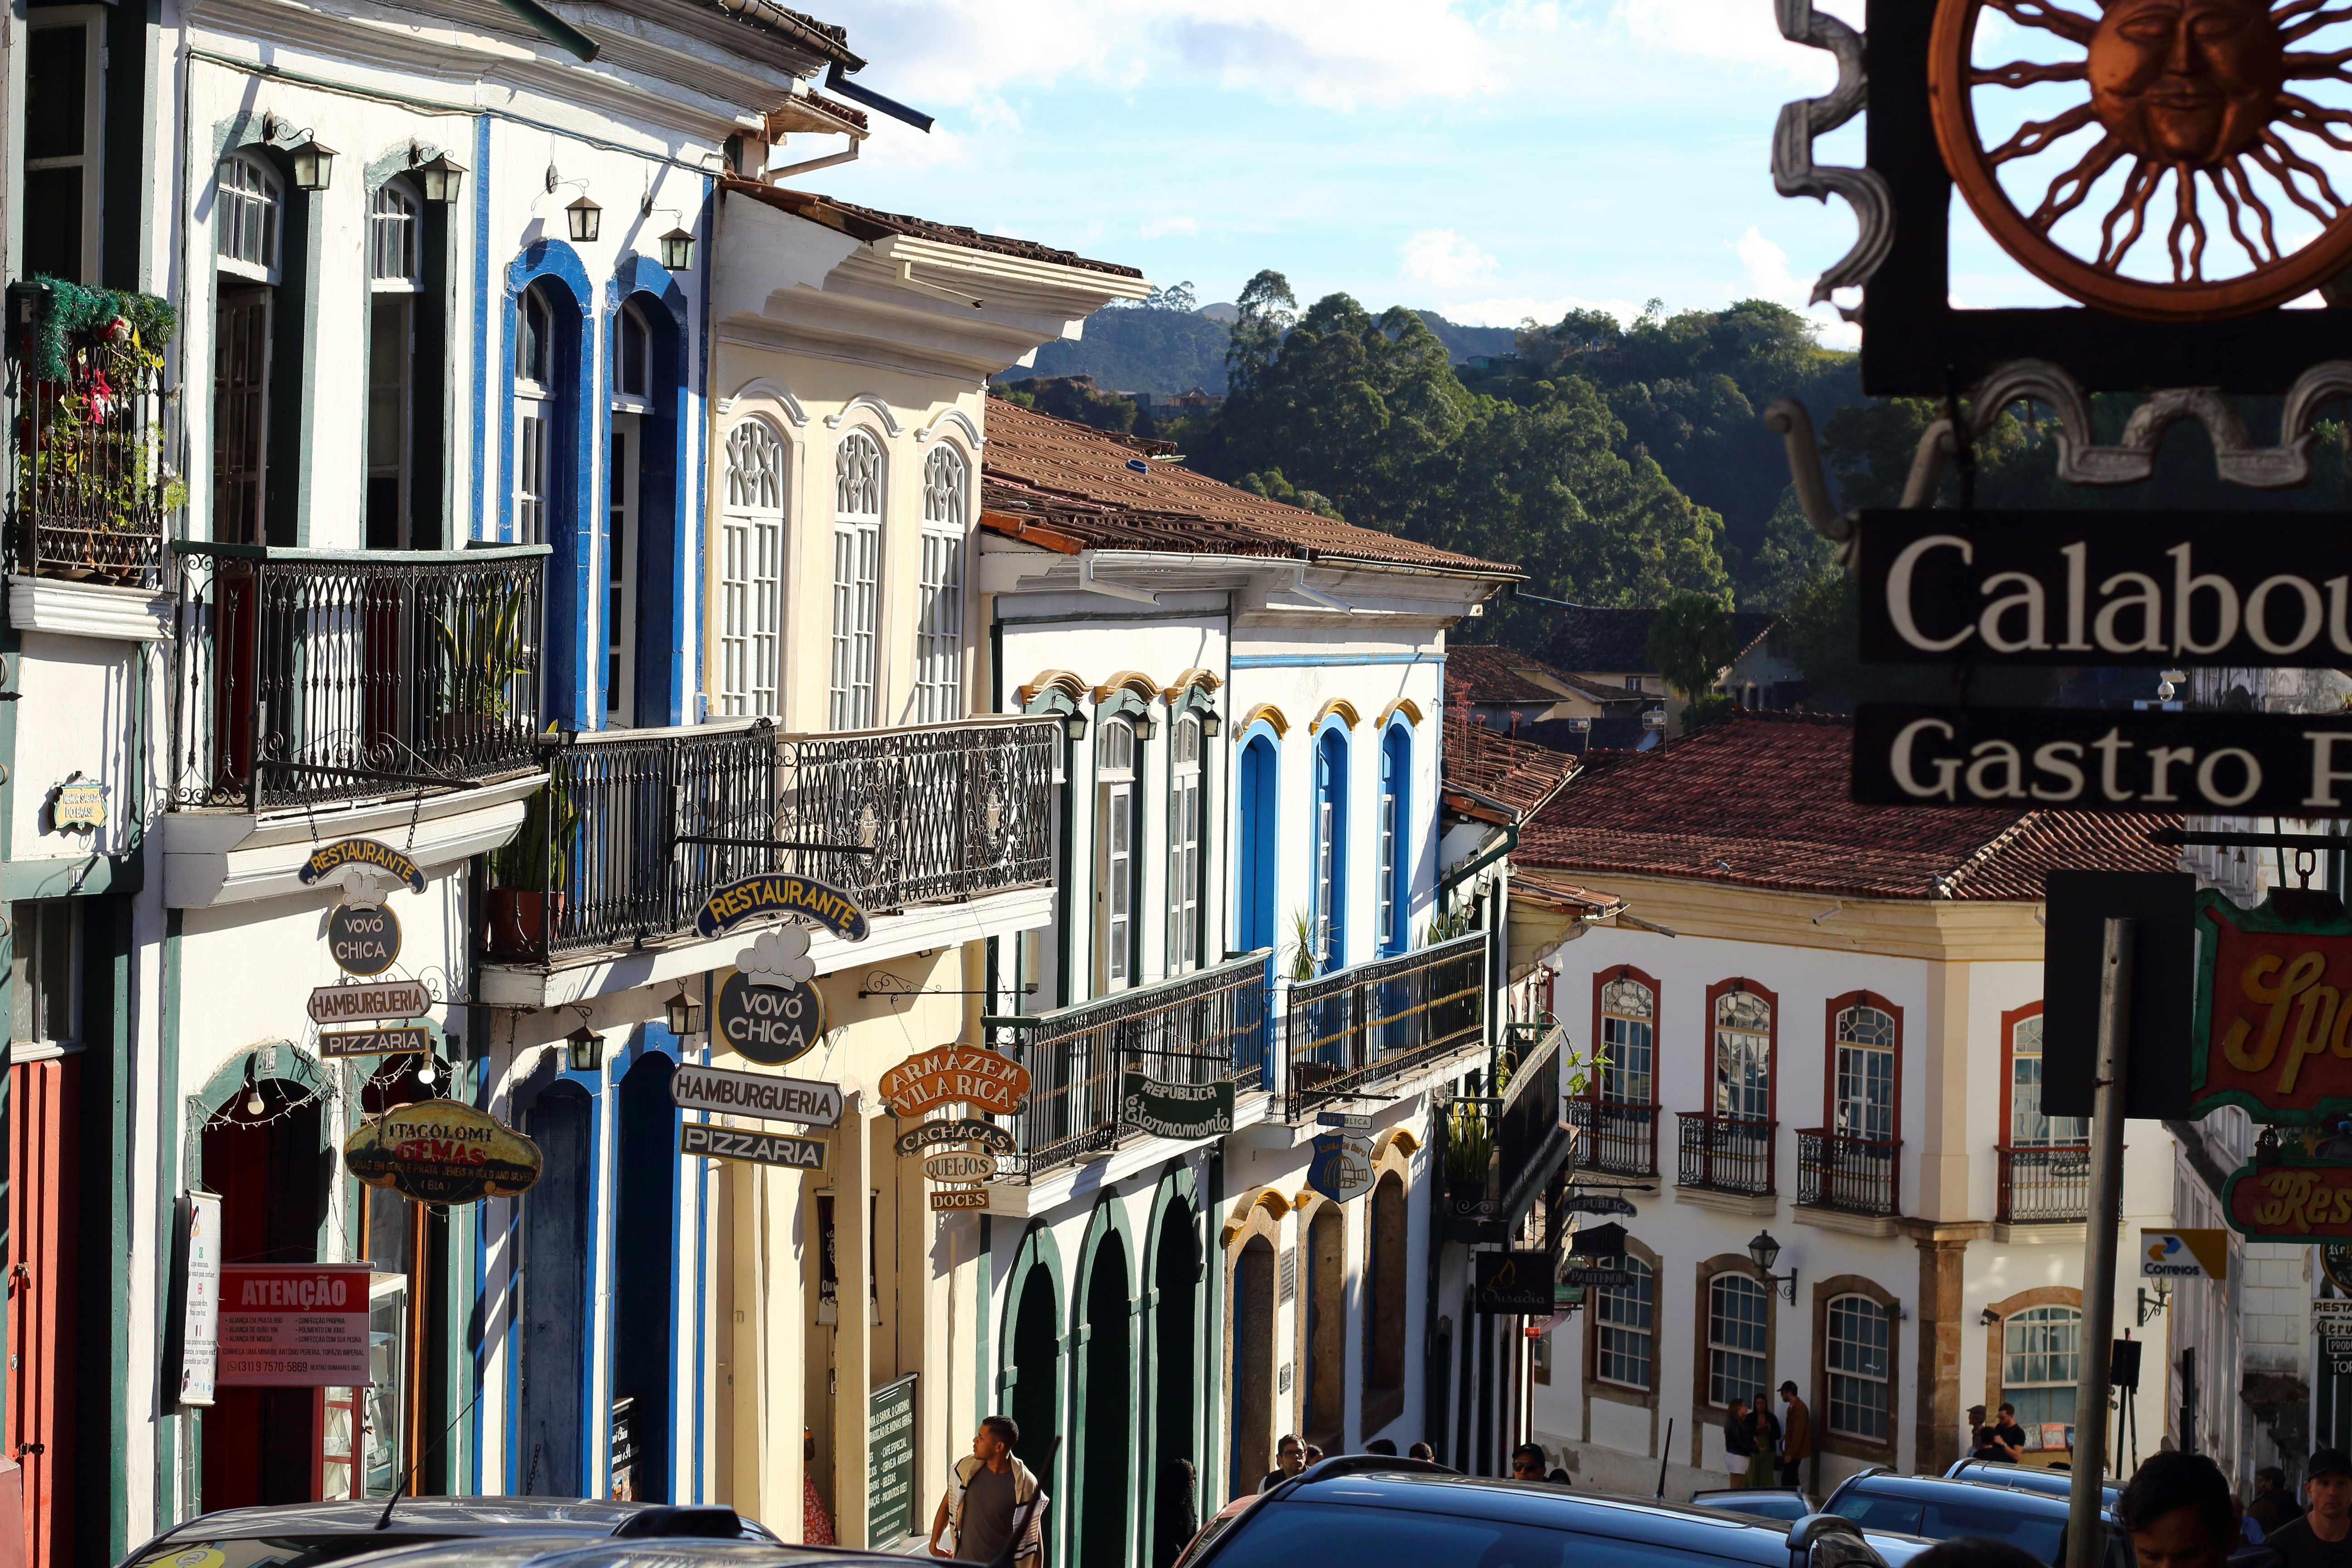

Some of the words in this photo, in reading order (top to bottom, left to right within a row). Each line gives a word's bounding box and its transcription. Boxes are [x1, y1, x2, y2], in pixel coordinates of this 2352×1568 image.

[1890, 718, 2263, 806] Gastro
[64, 793, 79, 804] MENOR
[80, 793, 99, 804] SACADA
[65, 806, 74, 818] DO
[75, 806, 94, 818] BRASIL
[310, 842, 416, 880] RESTAURANTE
[708, 879, 858, 929] RESTAURANTE
[344, 915, 384, 933] VOVÓ
[336, 941, 387, 959] CHICA
[313, 989, 424, 1018] HAMBURGUERIA
[741, 992, 803, 1019] VOVÓ
[329, 1032, 420, 1053] PIZZARIA
[728, 1017, 806, 1048] CHICA
[892, 1054, 1019, 1093] ARMAZEM
[676, 1073, 833, 1118] HAMBURGUERIA
[892, 1077, 952, 1110] VILA
[956, 1074, 1010, 1108] RICA
[1142, 1080, 1217, 1101] REPÚBLICA
[1125, 1094, 1231, 1137] Éternamente
[389, 1123, 494, 1142] ITACOLOMI
[902, 1126, 1008, 1150] CACHAÇAS
[395, 1139, 486, 1166] GEMAS
[685, 1128, 819, 1166] PIZZARIA
[374, 1161, 384, 1171] EM
[413, 1164, 437, 1175] PRATA
[495, 1171, 509, 1180] AND
[510, 1172, 533, 1182] SILVER
[926, 1157, 989, 1178] QUEIJOS
[933, 1193, 985, 1208] DOCES
[1569, 1198, 1631, 1213] REPÚBLICA
[1571, 1271, 1625, 1284] PARTENON
[2144, 1263, 2200, 1275] Correios
[241, 1275, 347, 1311] ATENÇÃO
[1482, 1286, 1546, 1304] Ousadia
[299, 1317, 325, 1325] CONFECÇÃO
[322, 1348, 342, 1356] TOPÁZIO
[238, 1362, 254, 1372] (31)
[256, 1362, 261, 1371] 9
[263, 1362, 307, 1372] 7570-5869
[876, 1414, 879, 1422] O
[891, 1406, 895, 1416] O
[895, 1399, 909, 1413] CARINHO
[885, 1423, 889, 1435] DE
[889, 1418, 901, 1432] MINAS
[882, 1443, 891, 1458] CAFÉ
[891, 1437, 907, 1454] ESPECIAL
[882, 1457, 897, 1473] CERVEJA
[882, 1485, 900, 1503] PRODUTOS
